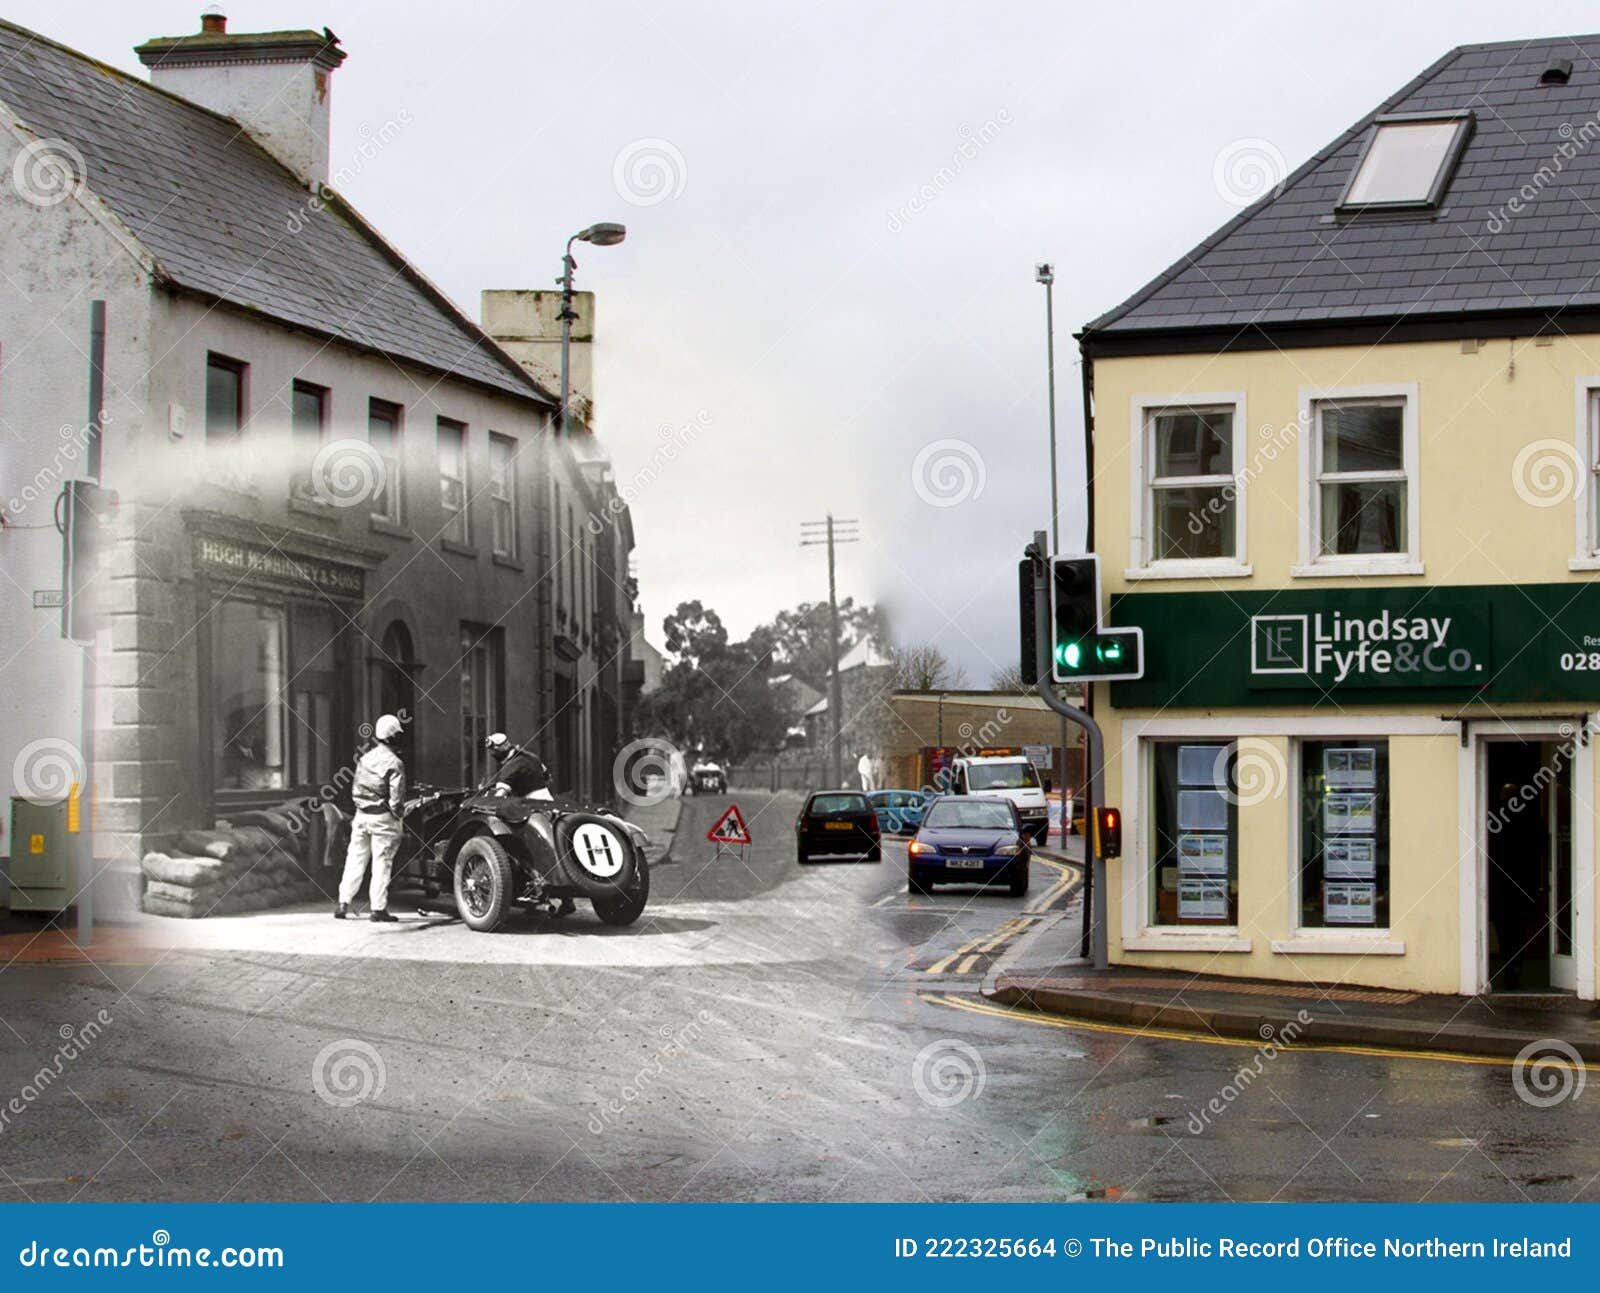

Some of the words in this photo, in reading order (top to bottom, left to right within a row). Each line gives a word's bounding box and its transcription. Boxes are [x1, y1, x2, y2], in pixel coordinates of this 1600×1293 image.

[202, 541, 244, 566] HUGH
[1315, 610, 1452, 648] Lindsay
[1560, 652, 1600, 671] 028
